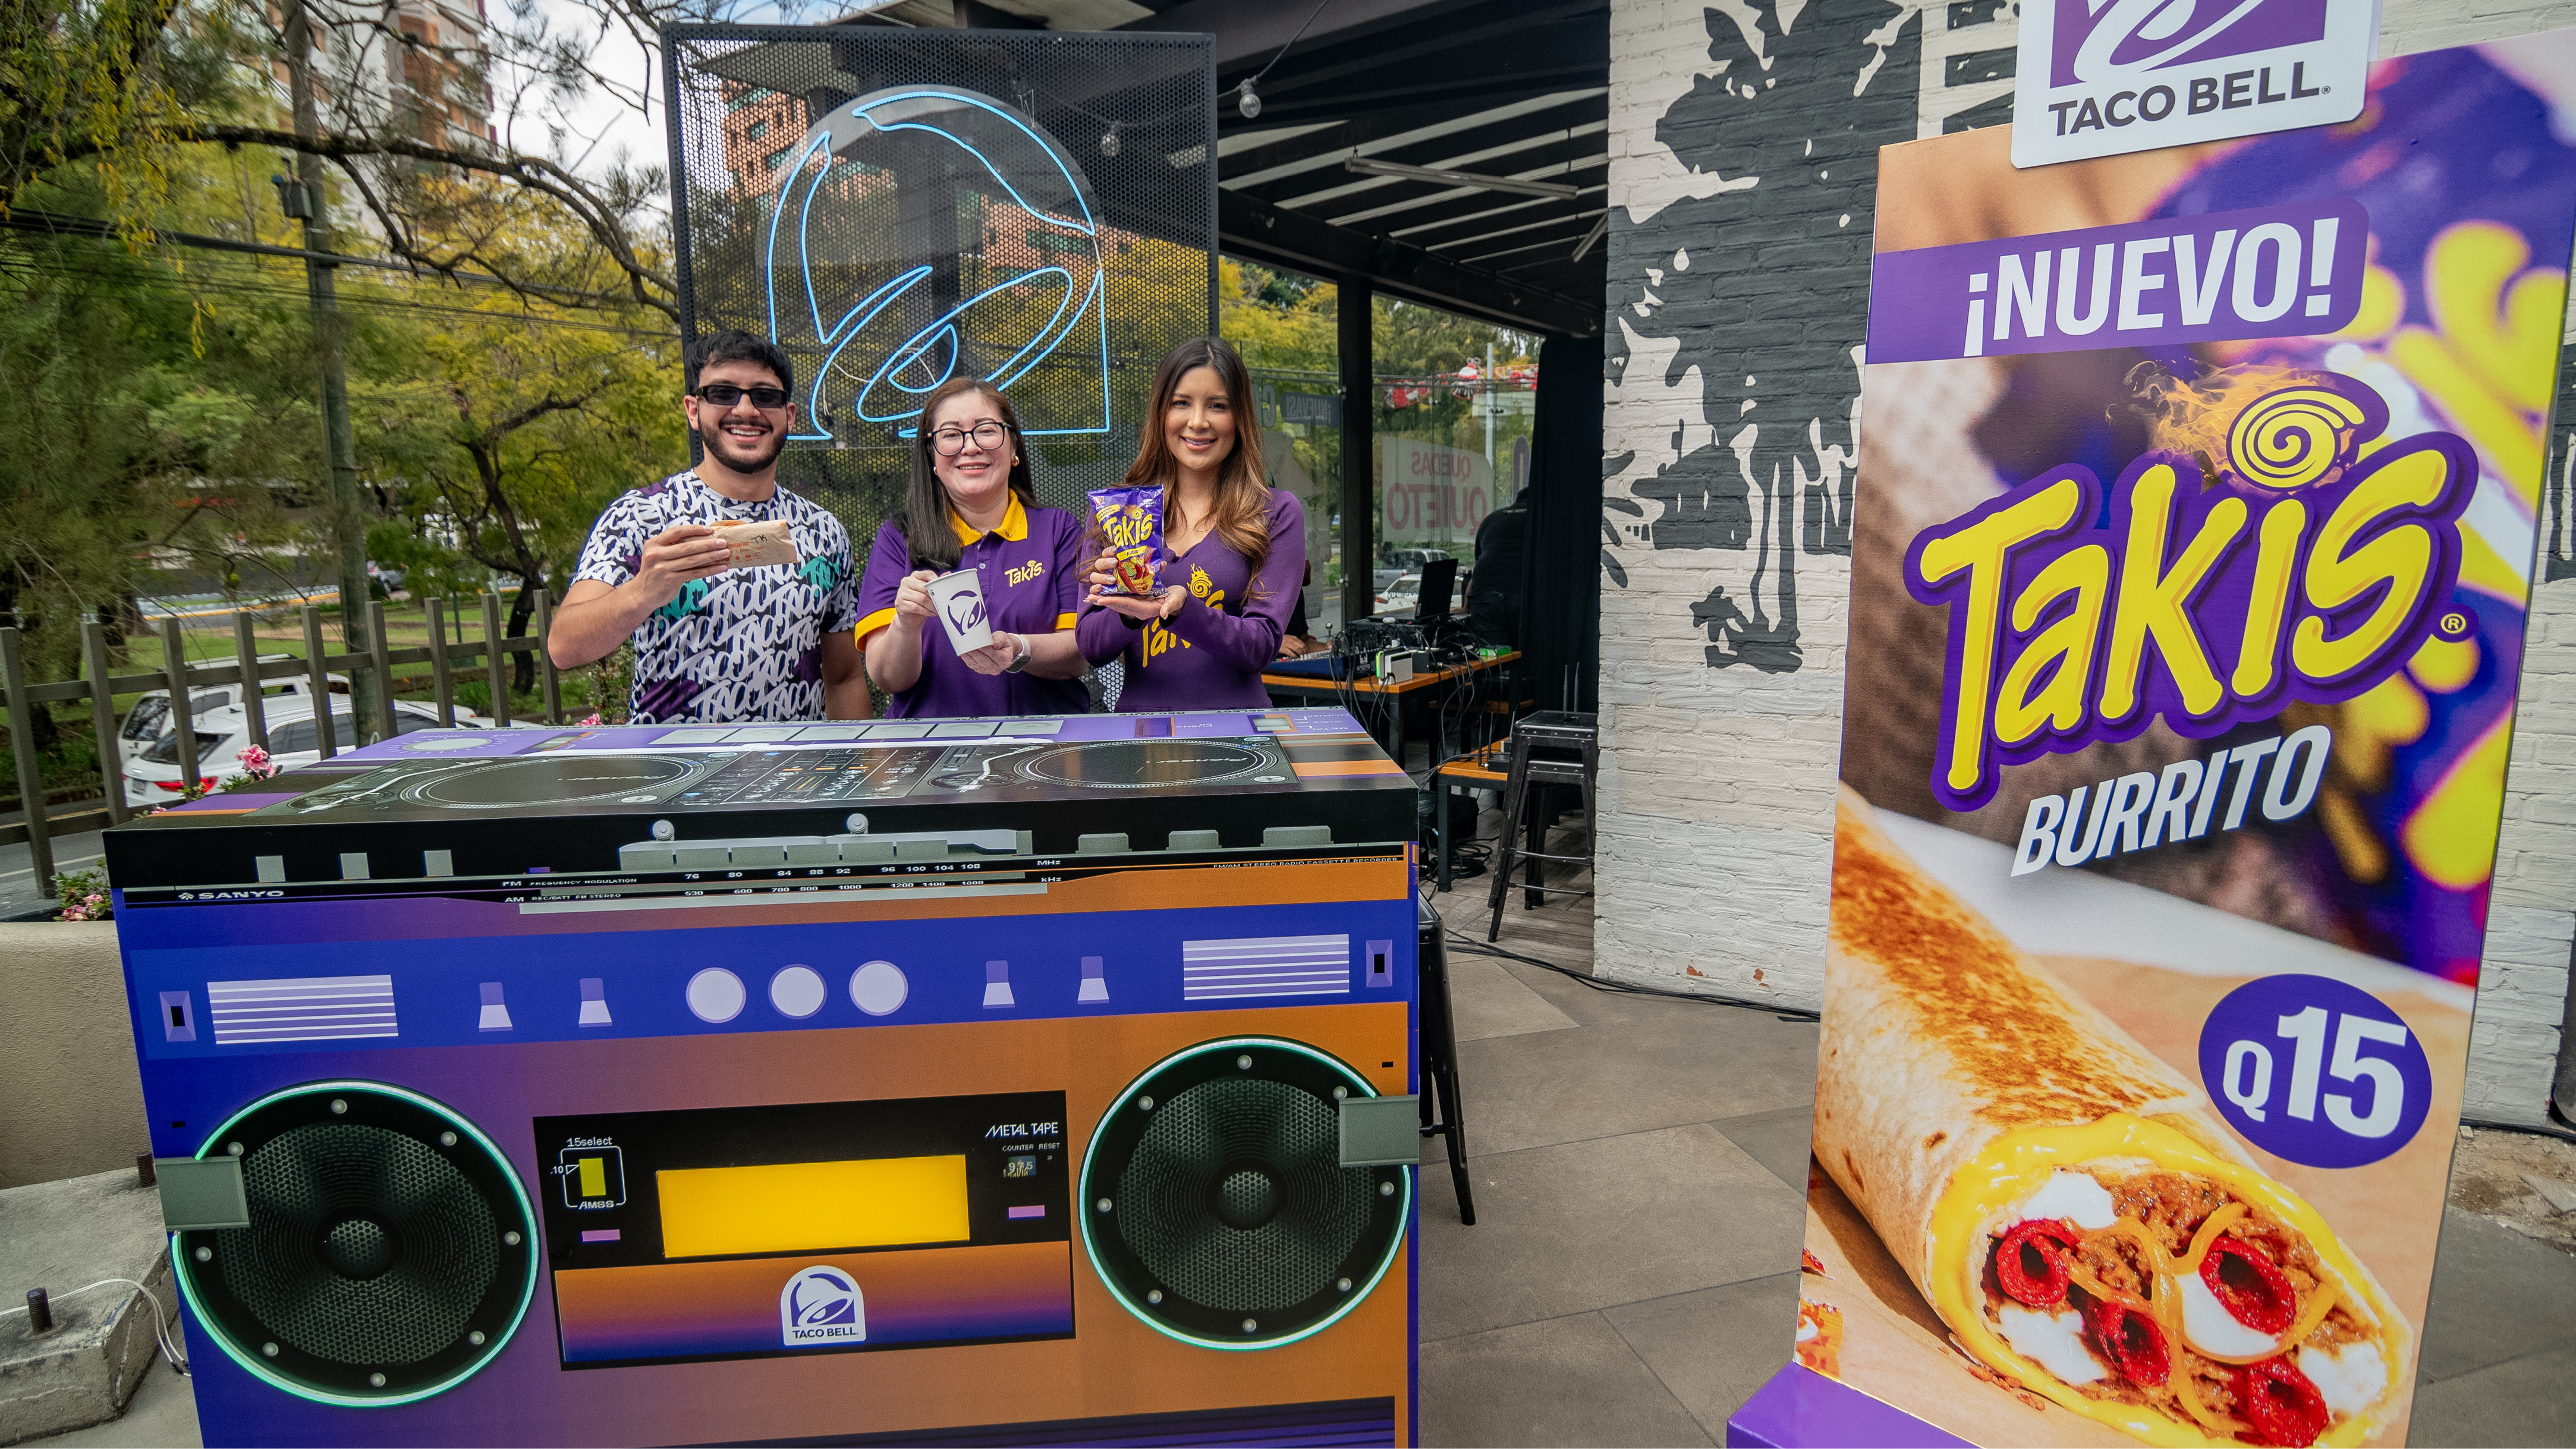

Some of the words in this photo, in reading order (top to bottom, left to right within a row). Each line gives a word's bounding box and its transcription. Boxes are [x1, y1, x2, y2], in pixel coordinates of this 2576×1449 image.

[2048, 85, 2175, 137] TACO
[1963, 217, 2340, 357] ¡NUEVO!
[1102, 508, 1153, 548] Takis
[1004, 560, 1043, 587] Takis
[2009, 724, 2332, 877] BURRITO
[199, 890, 284, 899] SANYO
[985, 1123, 1028, 1138] METAL
[1031, 1122, 1059, 1135] TAPE
[567, 1136, 612, 1147] 15select
[1002, 1144, 1034, 1152] COUNTER
[579, 1201, 615, 1209] AMSS
[792, 1328, 825, 1339] TACO
